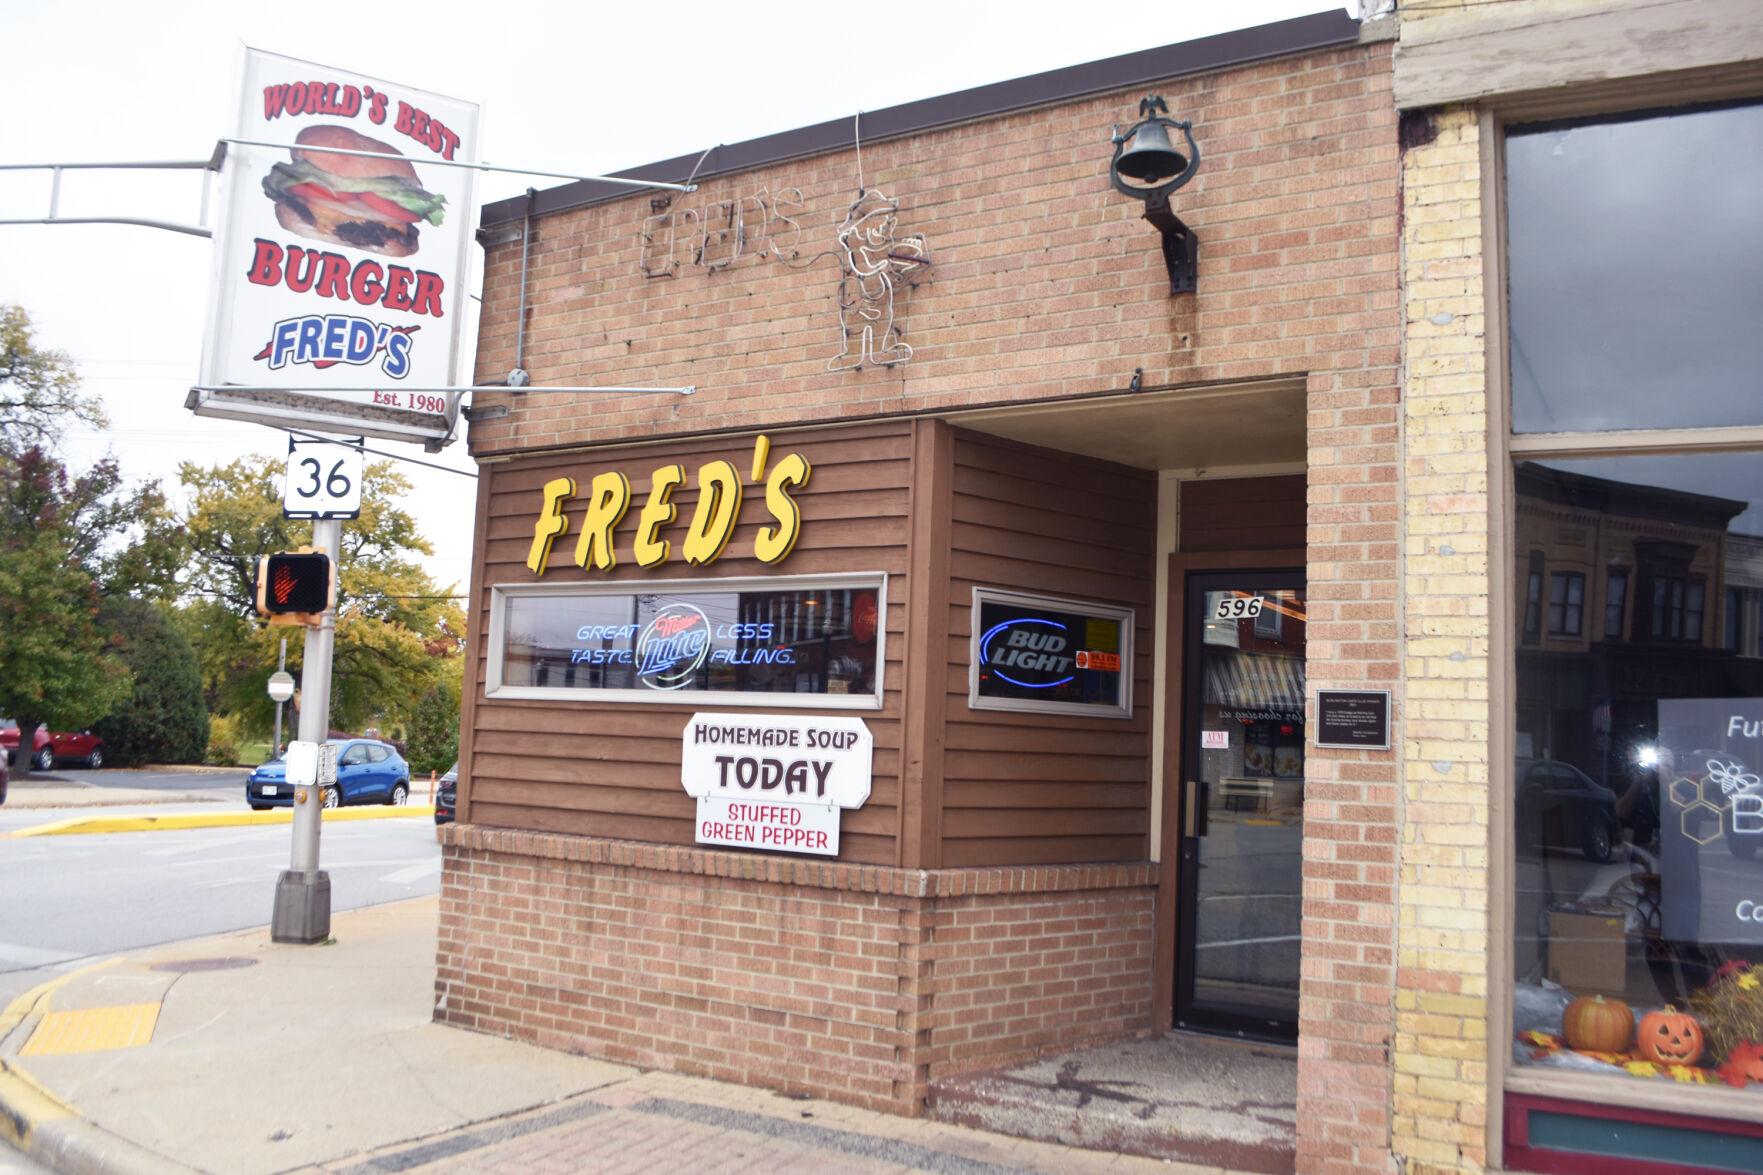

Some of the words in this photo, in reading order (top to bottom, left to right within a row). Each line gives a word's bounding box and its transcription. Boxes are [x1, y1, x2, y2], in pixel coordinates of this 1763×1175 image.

[263, 81, 388, 125] WORLD'S
[394, 100, 460, 161] BEST
[247, 238, 445, 317] BURGER
[268, 315, 413, 380] FRED'S
[407, 391, 445, 414] 1980
[296, 457, 352, 499] 36
[527, 435, 812, 576] FRED'S
[1217, 598, 1261, 618] 596
[577, 624, 640, 640] GREAT
[655, 613, 701, 638] Miller
[716, 623, 775, 639] LESS
[637, 629, 707, 676] Lite
[1007, 630, 1067, 653] BUD
[991, 647, 1074, 673] LIGHT
[695, 725, 799, 747] HOMEMADE
[807, 729, 859, 750] SOUP
[1727, 716, 1763, 737] Fu
[715, 756, 833, 797] TODAY
[728, 803, 801, 826] STUFFED
[702, 821, 755, 843] GREEN
[762, 826, 828, 849] PEPPER
